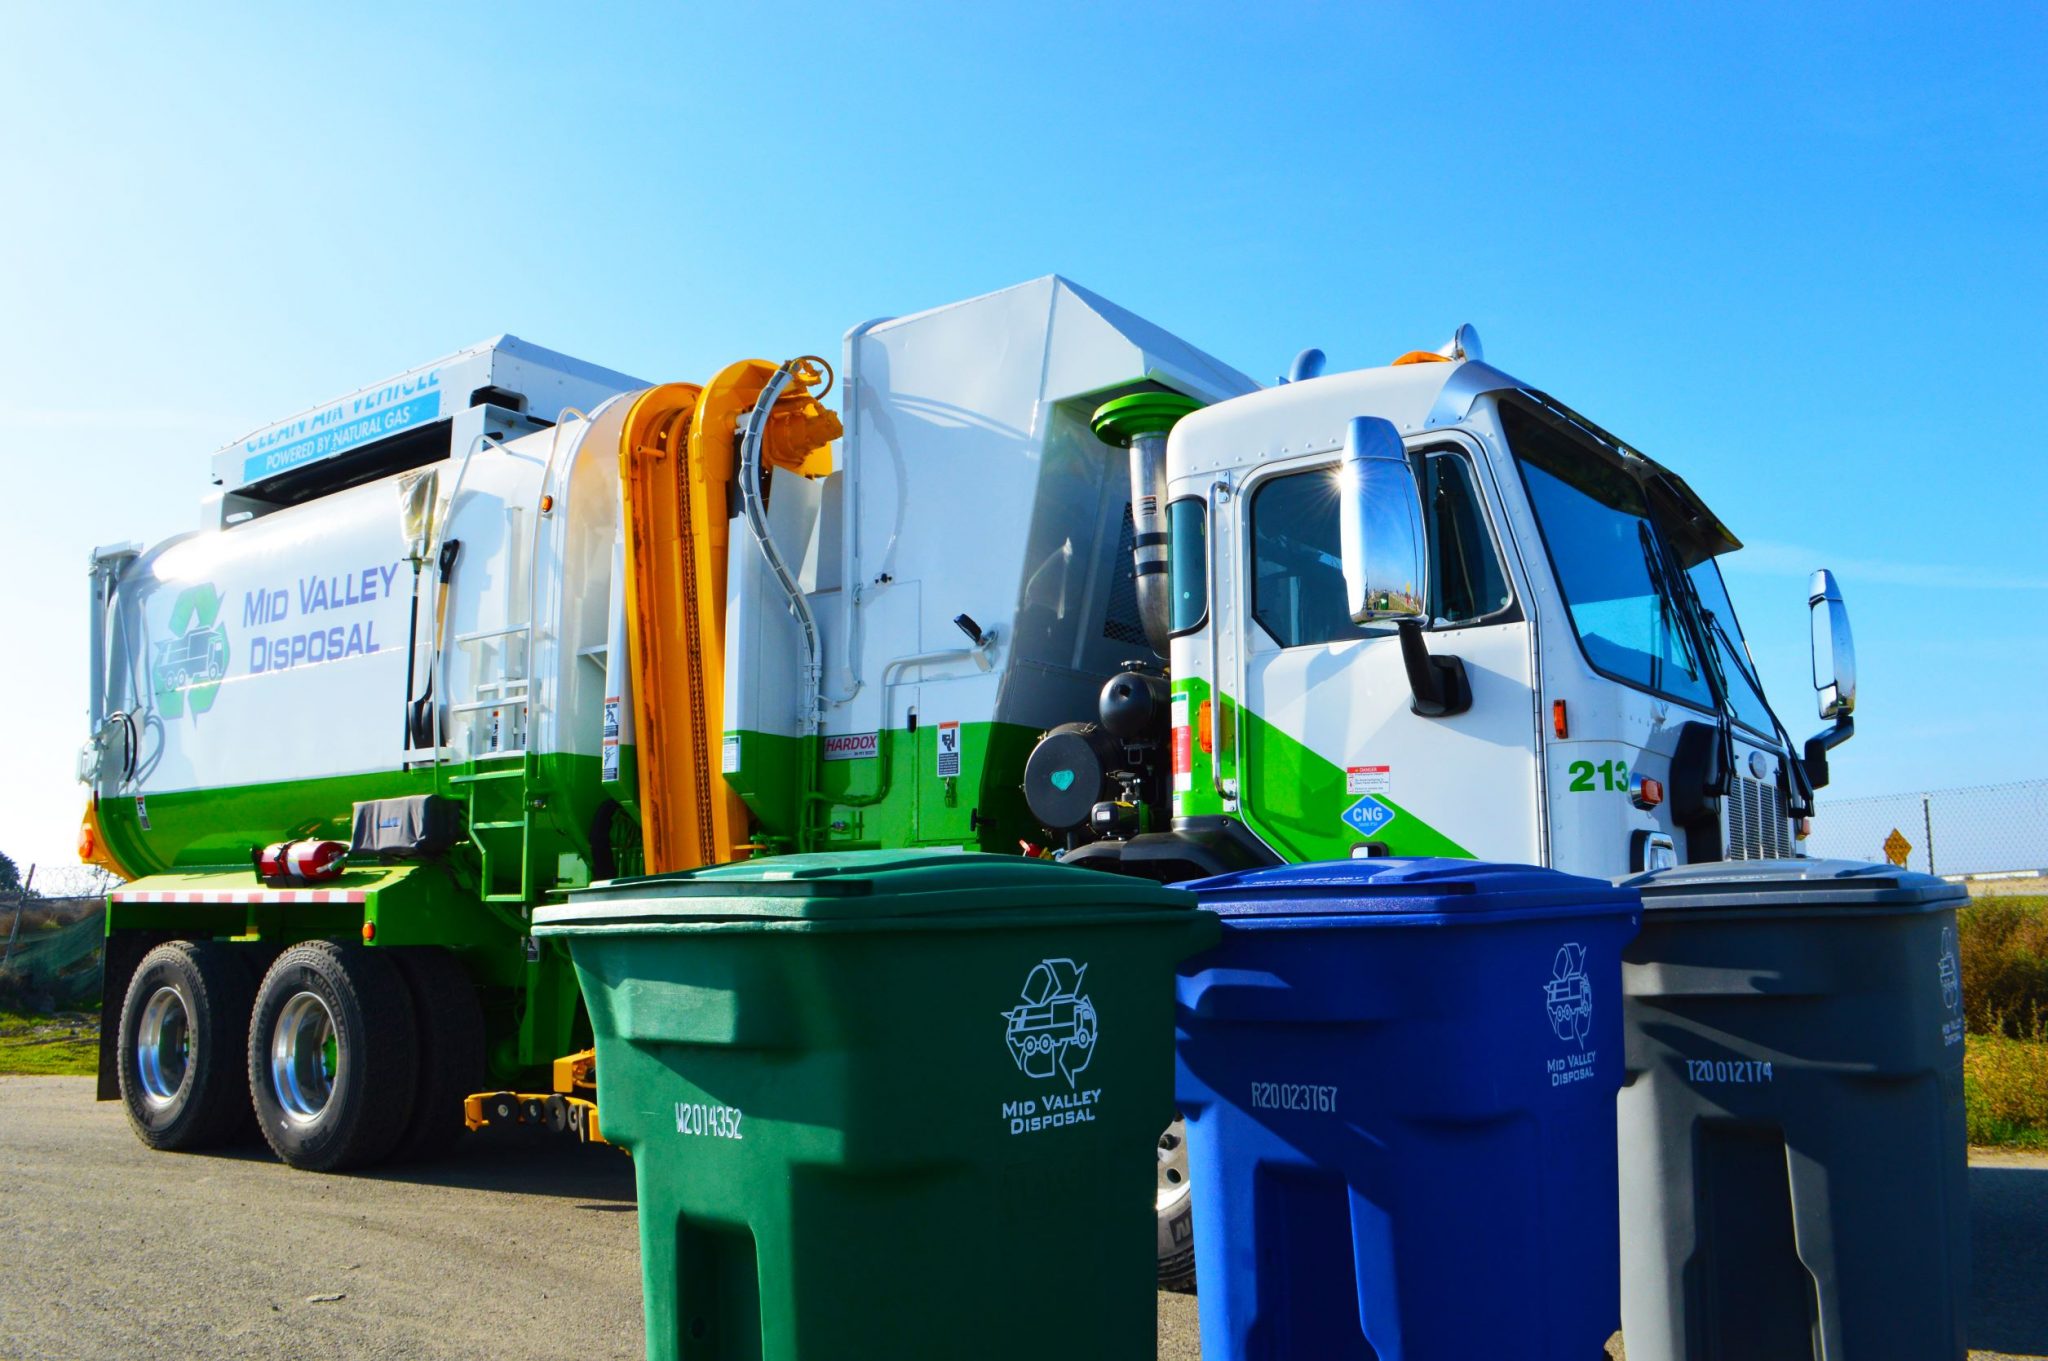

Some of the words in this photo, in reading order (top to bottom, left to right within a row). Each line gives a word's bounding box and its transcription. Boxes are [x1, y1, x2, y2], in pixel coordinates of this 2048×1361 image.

[266, 440, 315, 471] POWERED
[317, 434, 331, 453] BY
[333, 416, 382, 446] NATURAL
[384, 405, 410, 429] GAS
[243, 588, 289, 628] MID
[299, 562, 398, 615] VALLEY
[250, 620, 381, 674] DISPOSAL
[826, 735, 877, 752] HARDOX
[1568, 760, 1629, 792] 213
[1353, 807, 1383, 822] CNG
[1547, 1059, 1565, 1073] MID
[1568, 1051, 1596, 1068] VALLEY
[1552, 1066, 1594, 1087] DISPOSAL
[1002, 1101, 1036, 1119] MID
[1042, 1088, 1101, 1111] VALLEY
[1010, 1107, 1096, 1135] DISPOSAL
